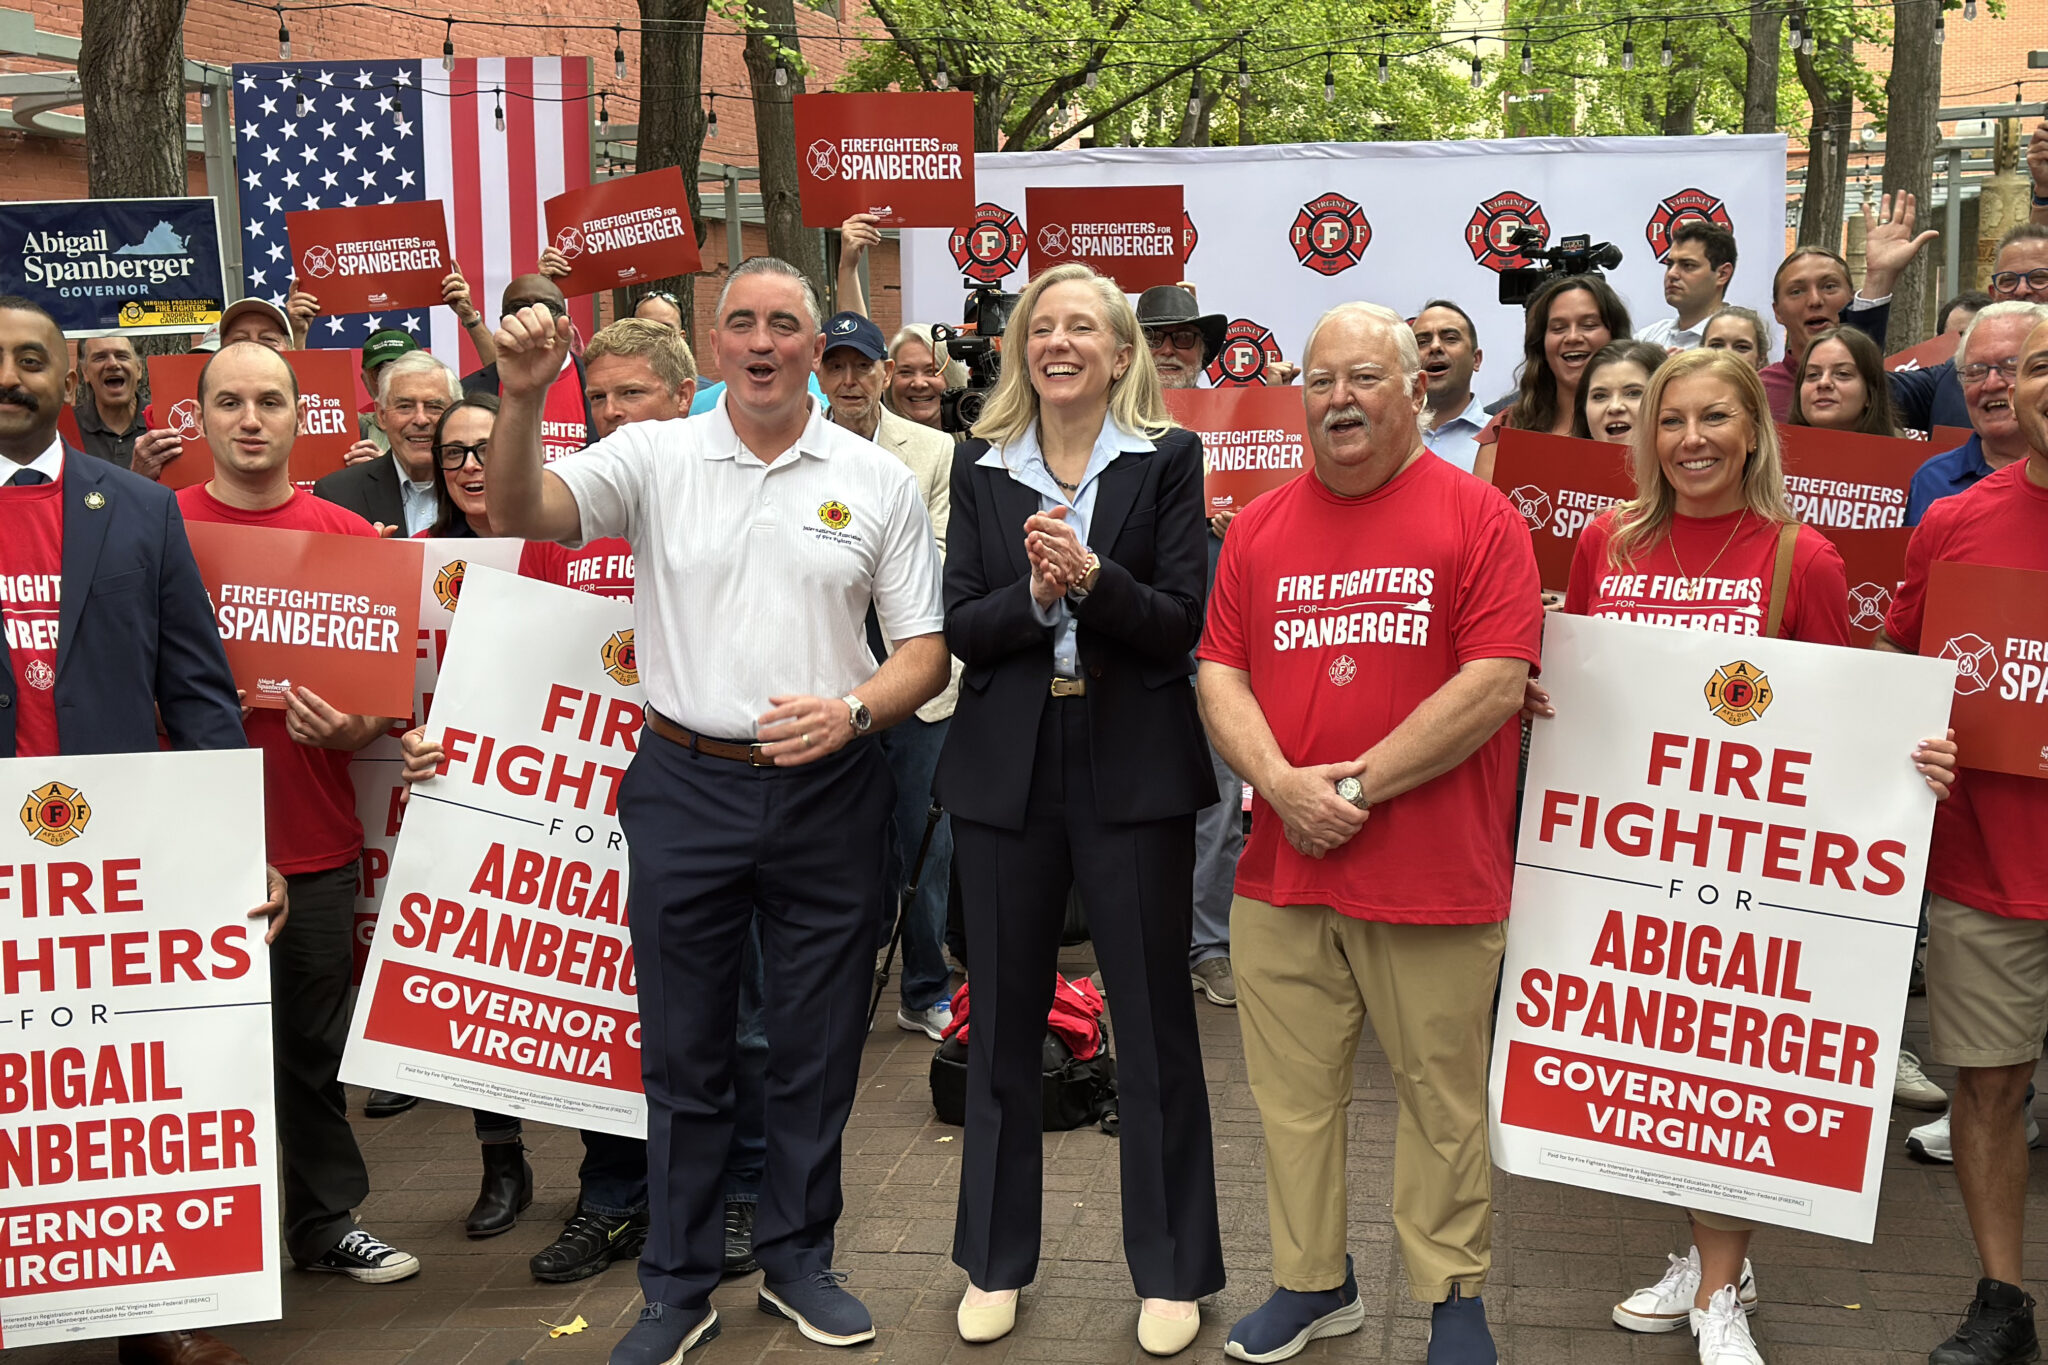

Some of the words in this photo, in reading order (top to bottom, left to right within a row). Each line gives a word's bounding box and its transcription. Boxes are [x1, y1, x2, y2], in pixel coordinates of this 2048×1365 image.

[841, 138, 939, 152] FIREFIGHTERS
[942, 144, 958, 152] FOR
[842, 154, 962, 180] SPANBERGER
[976, 210, 1006, 220] RGINIA
[1311, 201, 1350, 210] VIRGINIA
[1488, 199, 1528, 209] VIRGINIA
[1670, 197, 1710, 207] VIRGINIA
[583, 206, 662, 233] FIREFIGHTERS
[664, 208, 677, 216] FOR
[1071, 222, 1155, 235] FIREFIGHTERS
[1157, 226, 1170, 234] FOR
[1652, 223, 1664, 240] P
[22, 229, 109, 258] Abigail
[336, 237, 420, 254] FIREFIGHTERS
[422, 240, 436, 248] FOR
[586, 216, 684, 254] SPANBERGER
[953, 236, 965, 252] P
[979, 232, 998, 256] F
[1012, 234, 1023, 251] F
[1072, 235, 1174, 257] SPANBERGER
[1295, 227, 1306, 244] P
[1321, 222, 1341, 248] F
[1355, 226, 1366, 243] F
[1470, 225, 1483, 242] P
[24, 254, 194, 288] Spanberger
[338, 249, 442, 276] SPANBERGER
[60, 284, 149, 298] GOVERNOR
[1228, 326, 1260, 336] IRGINIA
[1233, 348, 1252, 372] F
[323, 399, 340, 407] FOR
[1286, 434, 1302, 442] FOR
[1783, 474, 1904, 504] FIREFIGHTERS
[567, 556, 602, 586] FIRE
[1276, 574, 1326, 602] FIRE
[1330, 567, 1434, 599] FIGHTERS
[220, 584, 370, 614] FIREFIGHTERS
[373, 604, 396, 617] FOR
[580, 584, 595, 592] FOR
[1600, 574, 1648, 598] FIRE
[1650, 575, 1763, 602] FIGHTERS
[1298, 605, 1318, 613] FOR
[1615, 600, 1635, 608] FOR
[218, 605, 399, 653] SPANBERGER
[1274, 612, 1429, 651] SPANBERGER
[1735, 663, 1748, 675] A
[1731, 685, 1748, 702] F
[1758, 688, 1768, 703] F
[541, 684, 645, 753] FIR
[435, 727, 627, 817] FIGHT
[1647, 732, 1813, 808] FIRE
[48, 784, 61, 796] A
[48, 805, 64, 823] F
[77, 805, 86, 819] F
[549, 818, 622, 850] FOR
[1539, 789, 1908, 896] FIGHTERS
[469, 842, 628, 926] ABIGA
[1668, 880, 1752, 912] FOR
[2, 925, 250, 995] HTERS
[1590, 909, 1813, 1003] ABIGAIL
[21, 1004, 108, 1029] FOR
[403, 975, 616, 1044] GOVERNOR
[1516, 968, 1880, 1089] SPANBERGER
[449, 1020, 612, 1080] VIRGINIA
[0, 1040, 183, 1114] BIGAIL
[1534, 1056, 1771, 1128] GOVERNOR
[1783, 1103, 1844, 1138] OF
[1586, 1102, 1775, 1168] VIRGINIA
[0, 1108, 257, 1190] NBERGER
[176, 1196, 234, 1230] OF
[0, 1242, 176, 1288] IRGINIA
